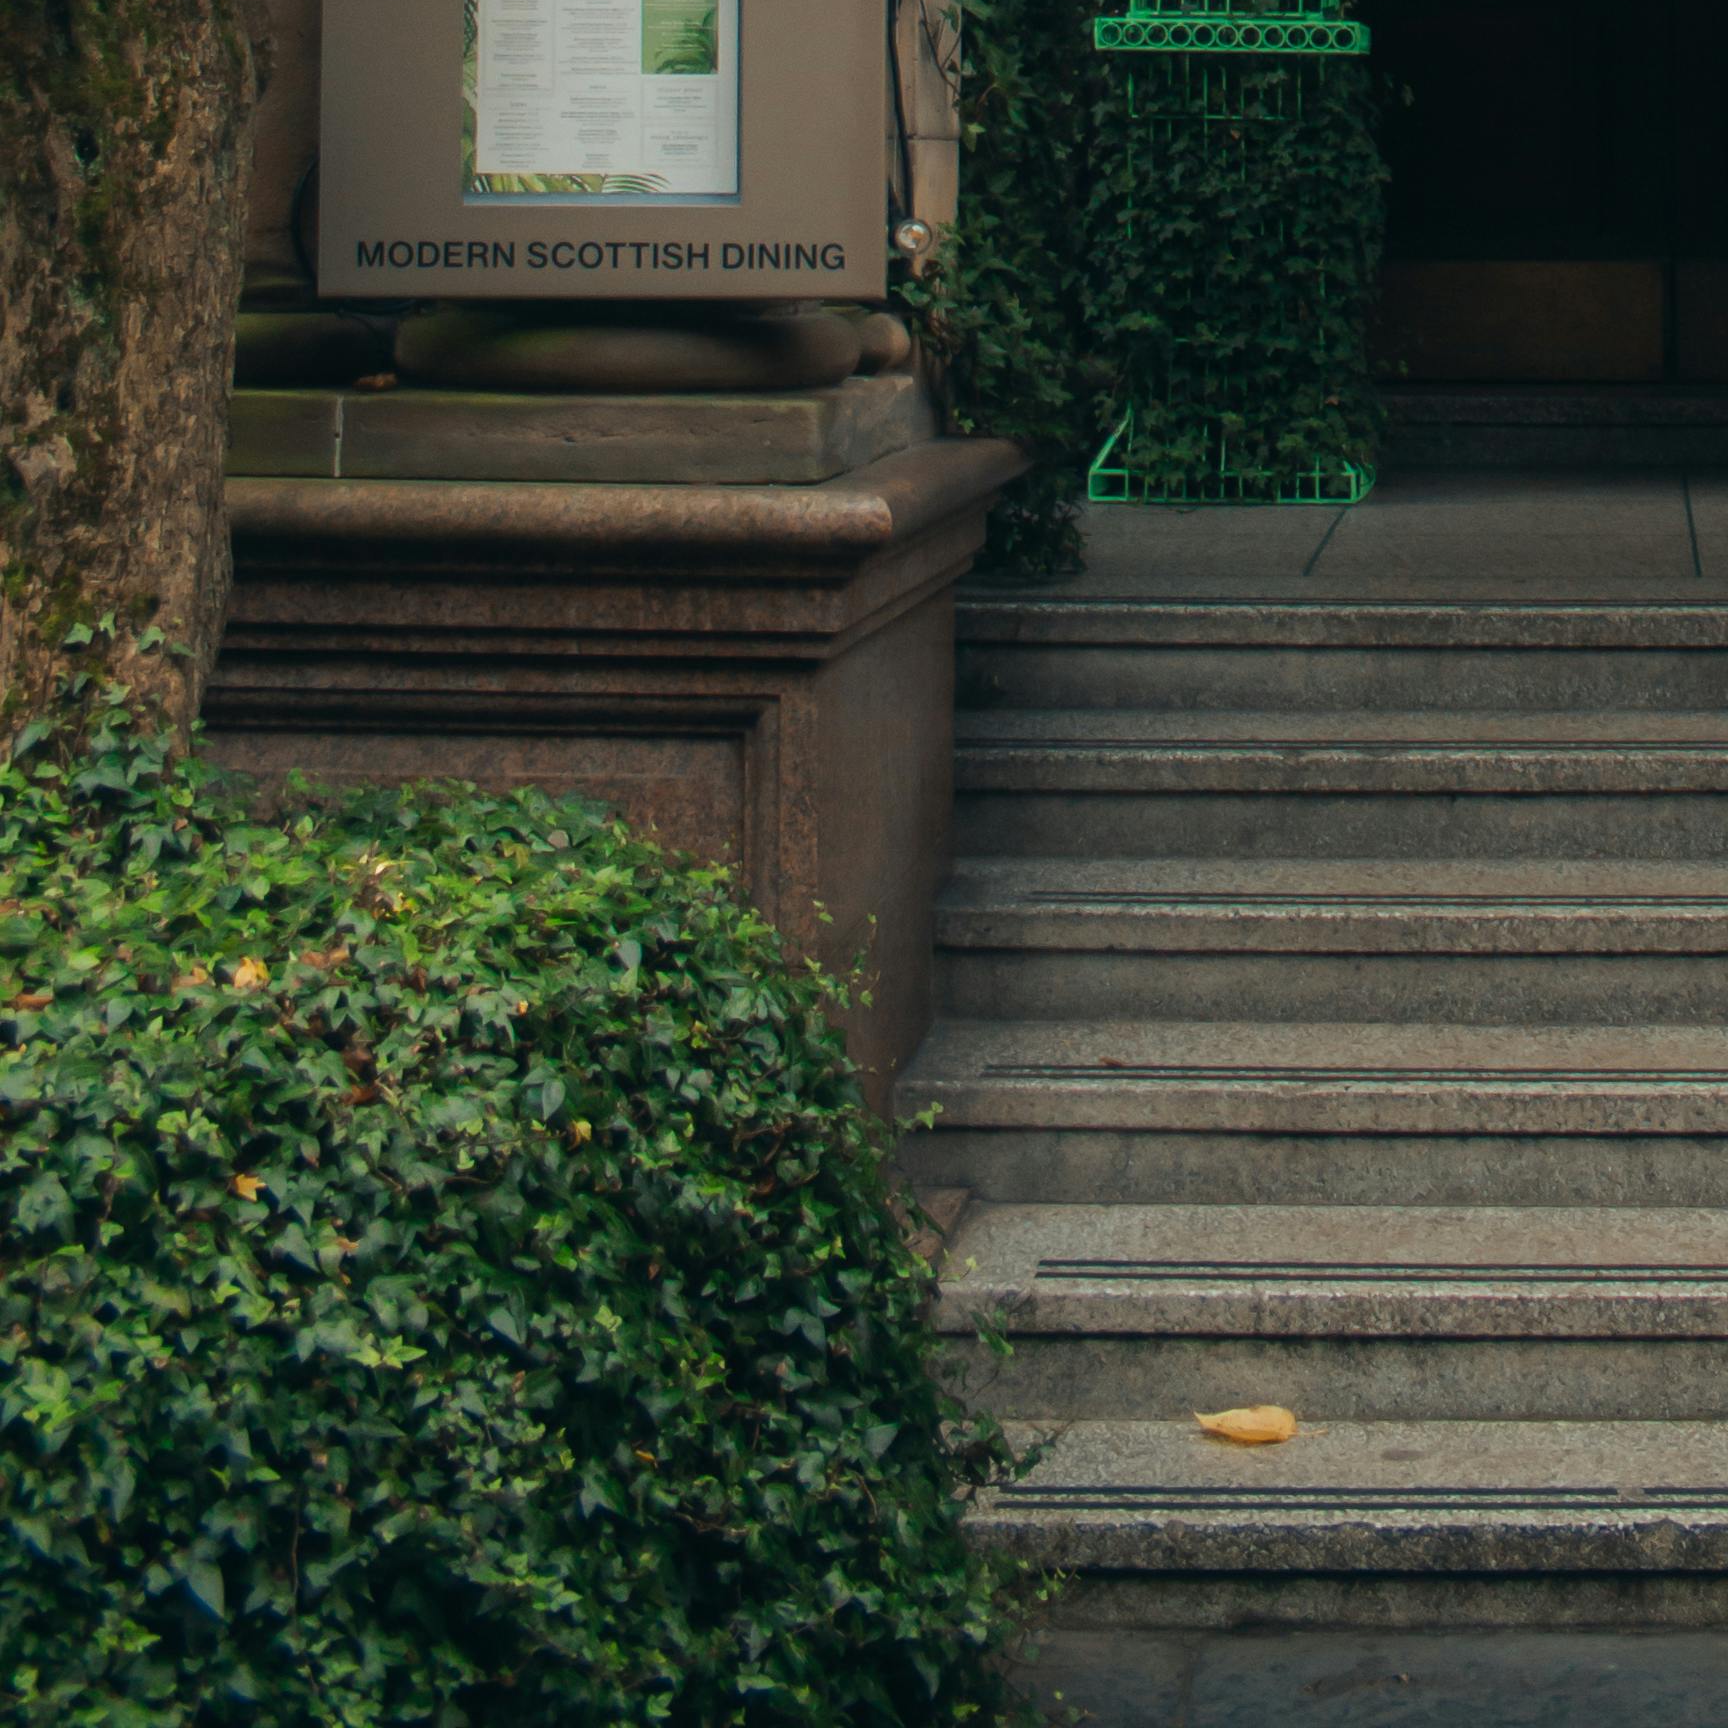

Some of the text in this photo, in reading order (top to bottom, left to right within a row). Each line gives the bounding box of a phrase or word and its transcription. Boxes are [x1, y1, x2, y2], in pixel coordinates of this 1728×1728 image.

[357, 241, 846, 272] MODERN SCOTTISH DINING
